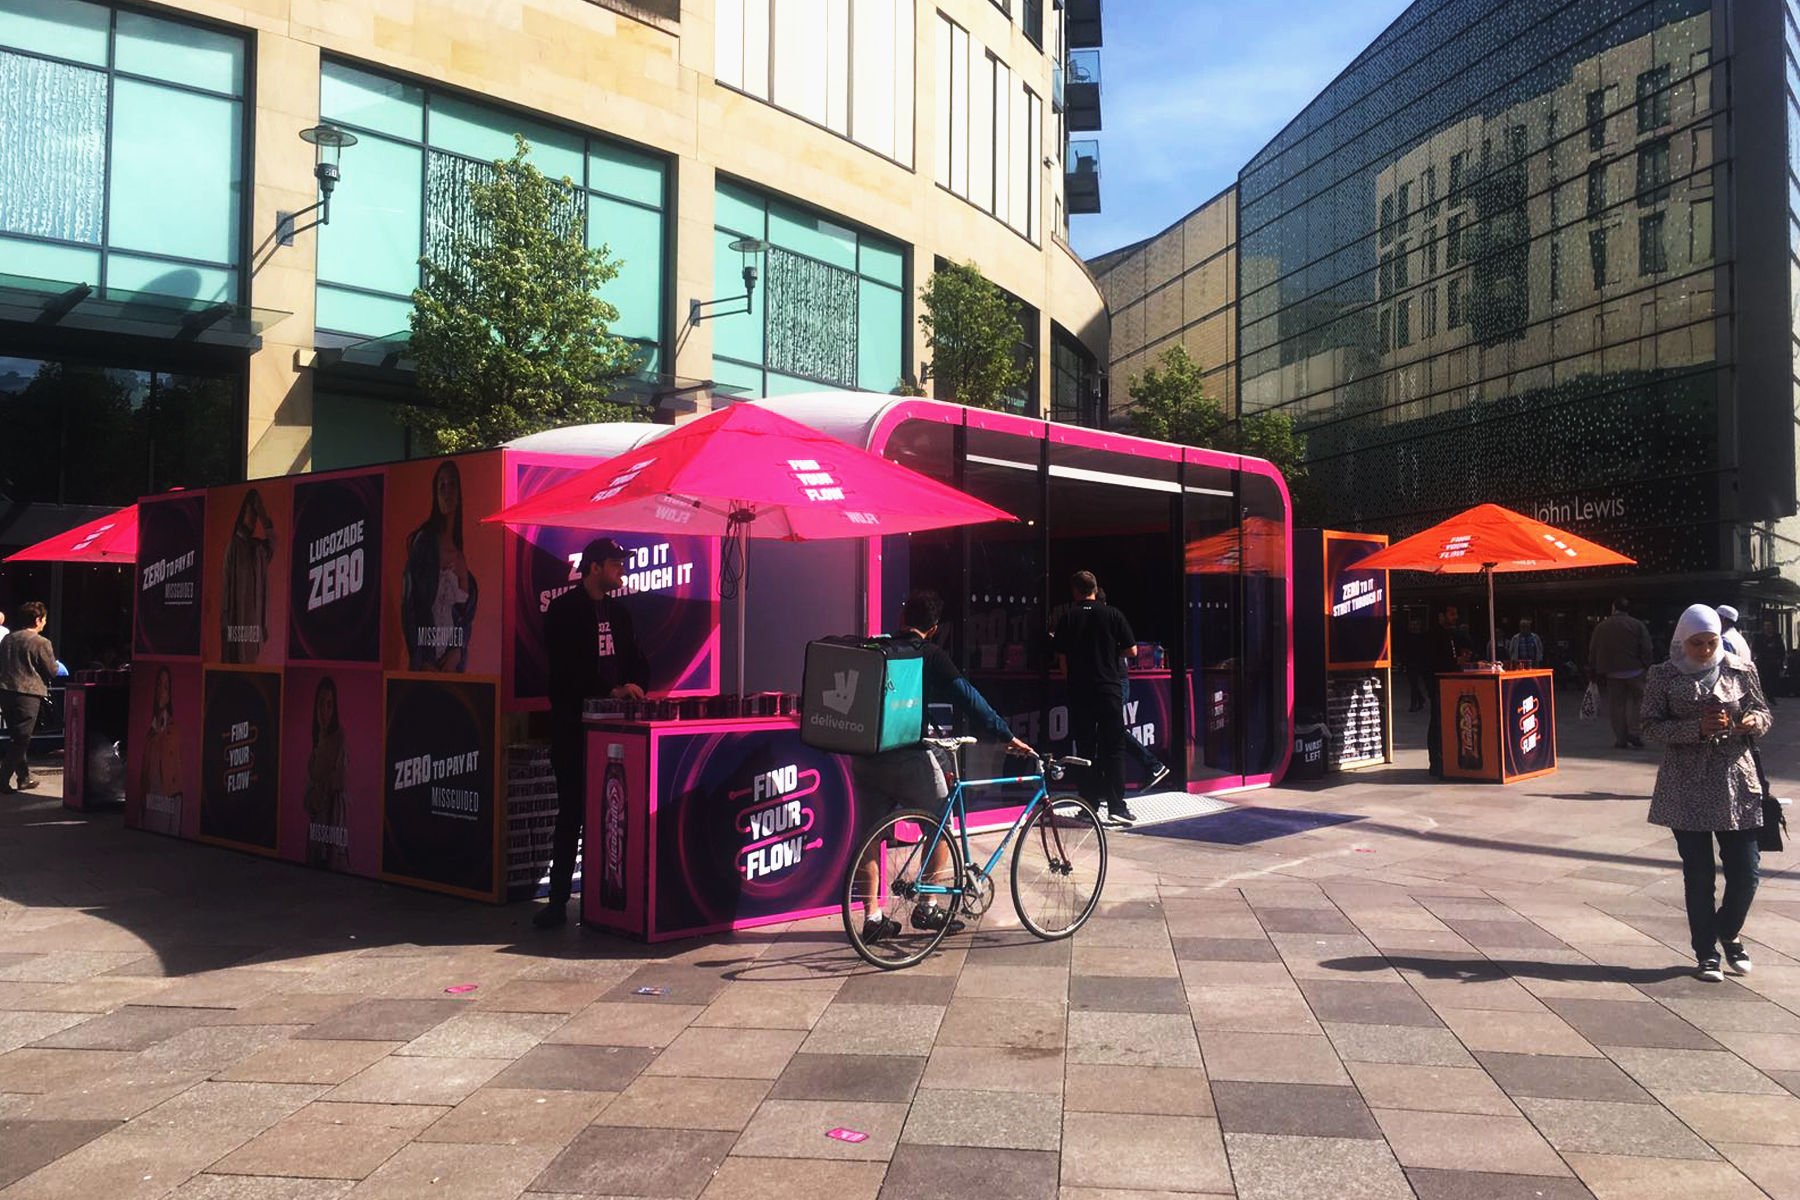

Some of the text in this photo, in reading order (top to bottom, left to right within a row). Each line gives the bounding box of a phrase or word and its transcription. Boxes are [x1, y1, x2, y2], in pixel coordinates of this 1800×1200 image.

[805, 487, 845, 502] FLOW
[1533, 495, 1625, 524] John Lewis
[309, 519, 365, 564] LUCOZADE
[653, 543, 669, 566] IT
[142, 550, 195, 592] ZERO TO PAY AT
[307, 548, 365, 613] ZERO
[605, 563, 694, 598] ROUGH IT
[1342, 580, 1360, 601] ZERO
[417, 626, 464, 647] MISSGUIDED
[231, 721, 250, 742] FIND
[811, 713, 865, 733] deliveroo
[229, 745, 250, 767] YOUR
[227, 770, 250, 793] FLOW
[394, 750, 480, 791] ZERO TO PAY AT
[754, 764, 798, 802] FIND
[431, 786, 479, 813] MISSGUIDED
[750, 800, 801, 841] YOUR
[309, 822, 348, 847] MISSGUIDED
[746, 835, 803, 881] FLOW
